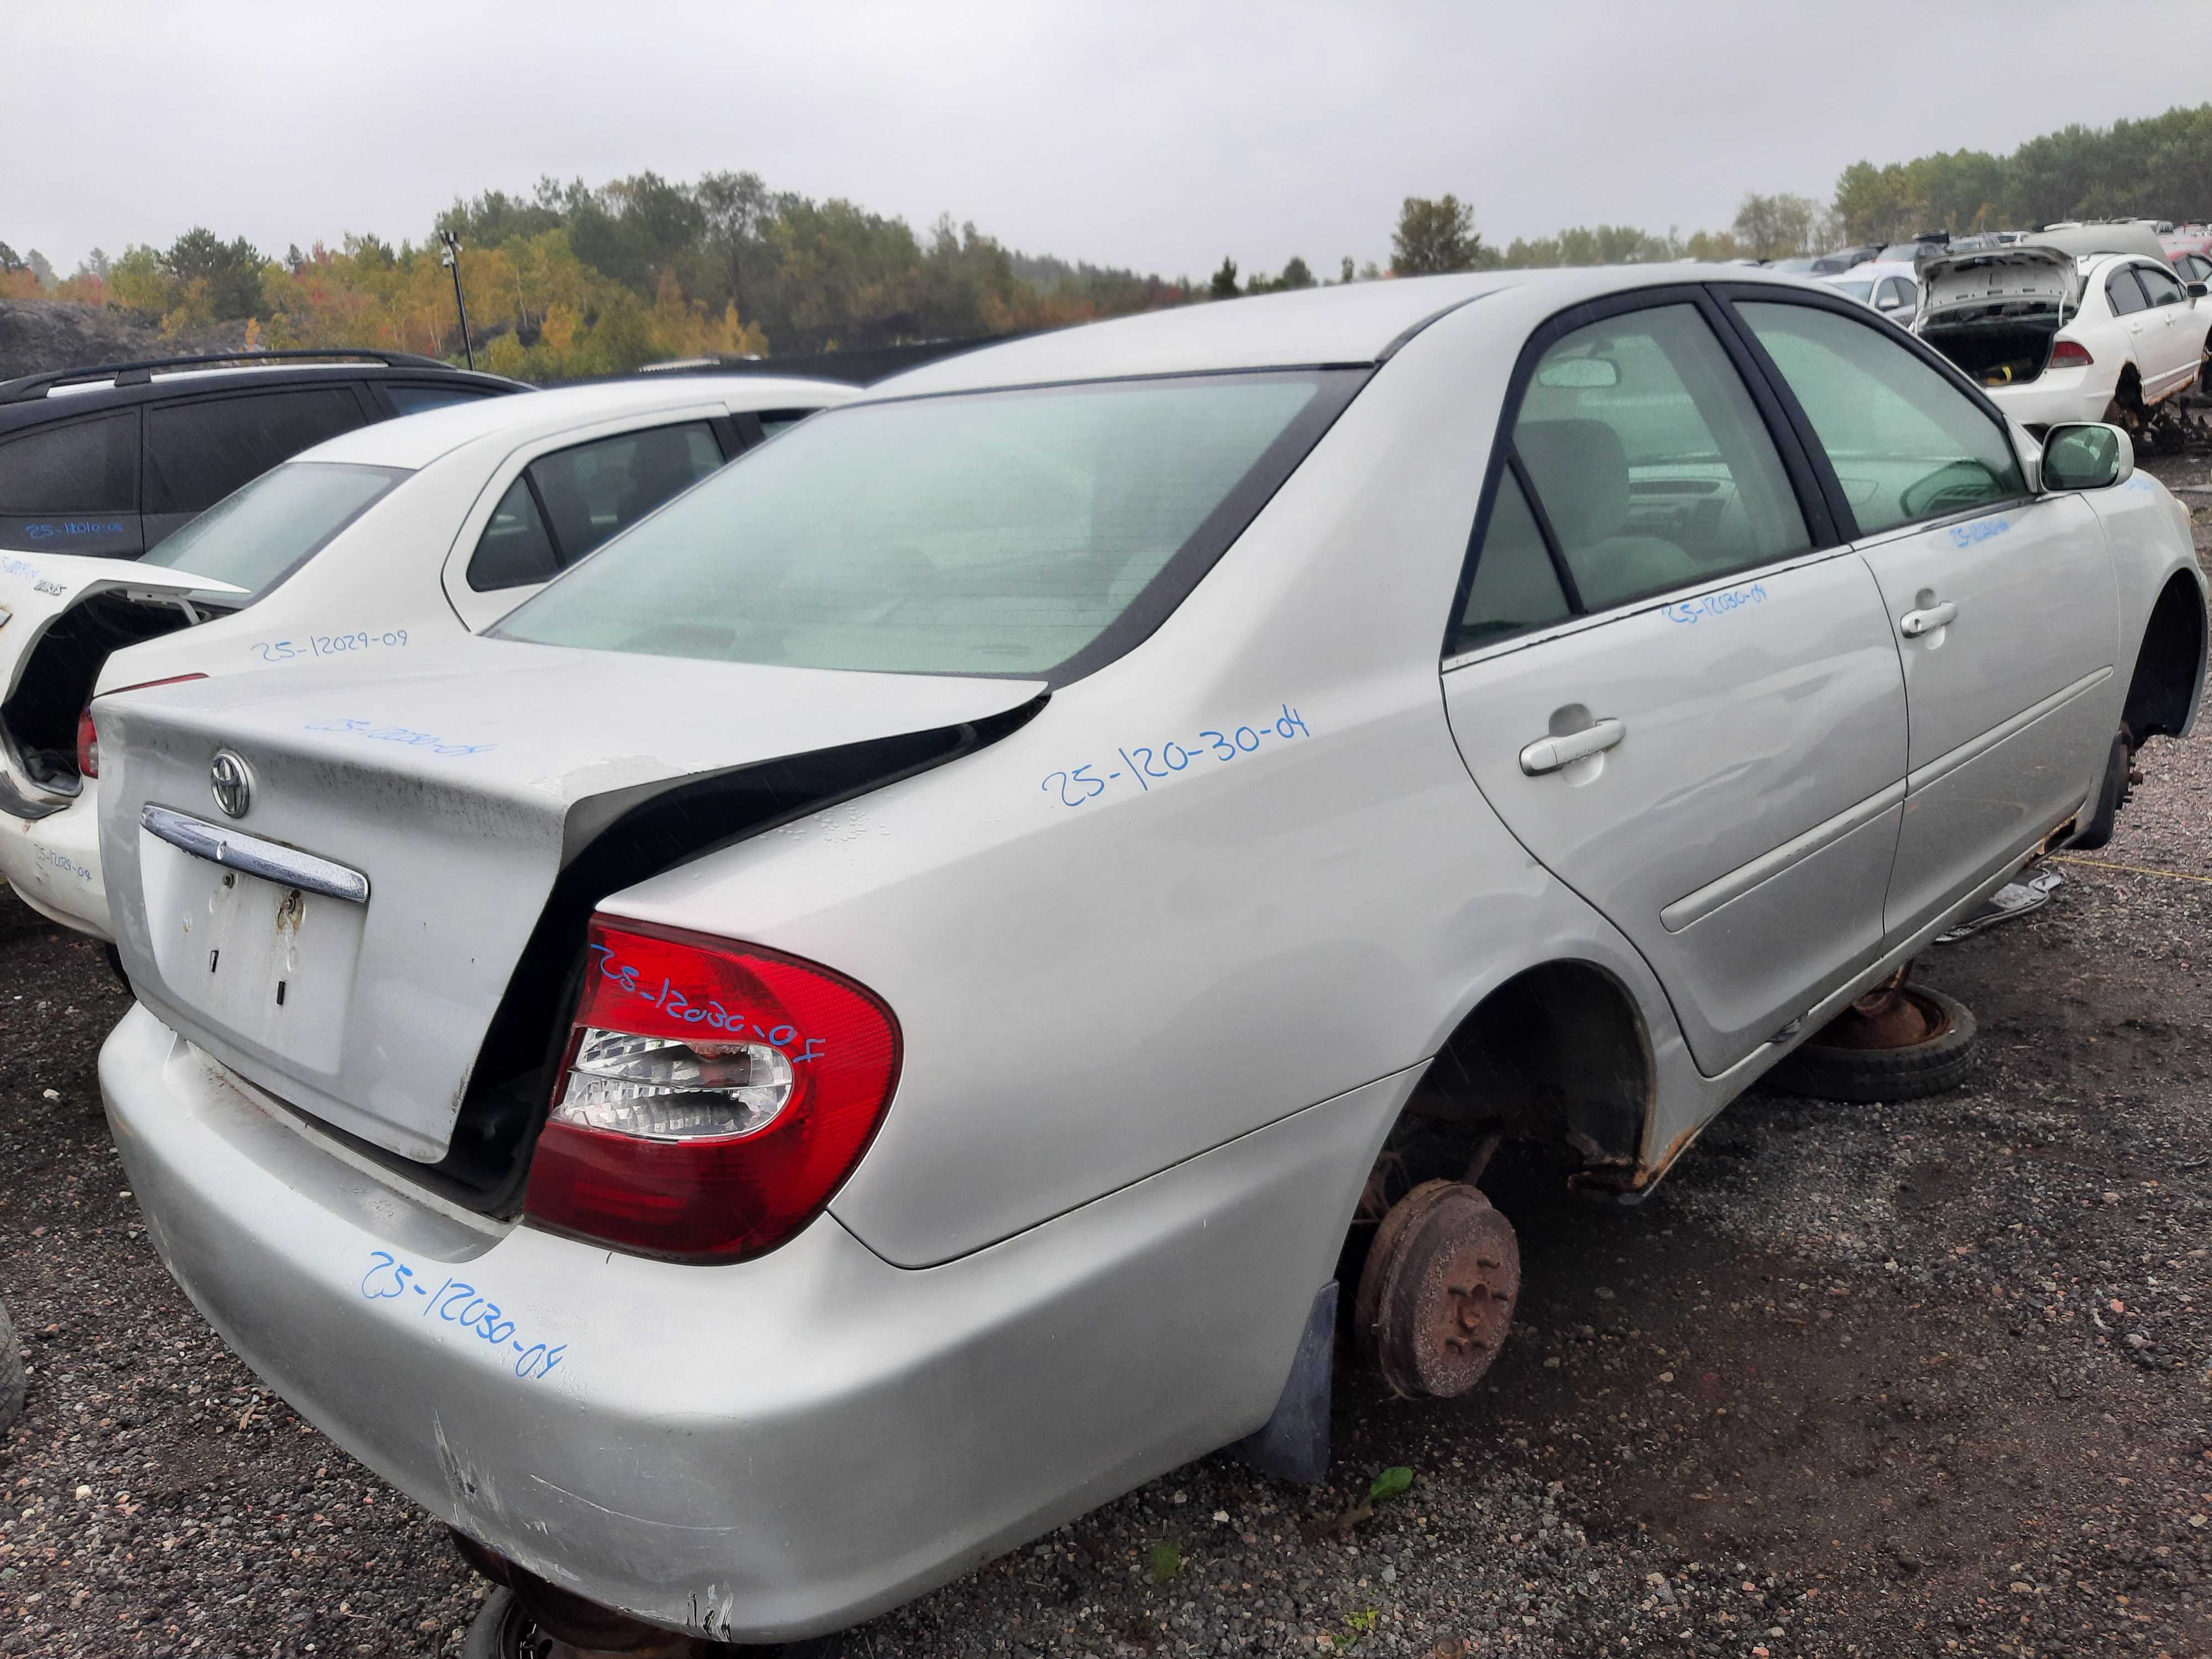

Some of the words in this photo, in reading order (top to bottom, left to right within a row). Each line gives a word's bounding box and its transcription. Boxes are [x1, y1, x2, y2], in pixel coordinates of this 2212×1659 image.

[251, 630, 408, 661] 25-12029-09
[1042, 704, 1310, 806] 25-120-30-04
[591, 943, 826, 1062] 25-12030-04
[362, 1251, 567, 1379] 25-12030-04
